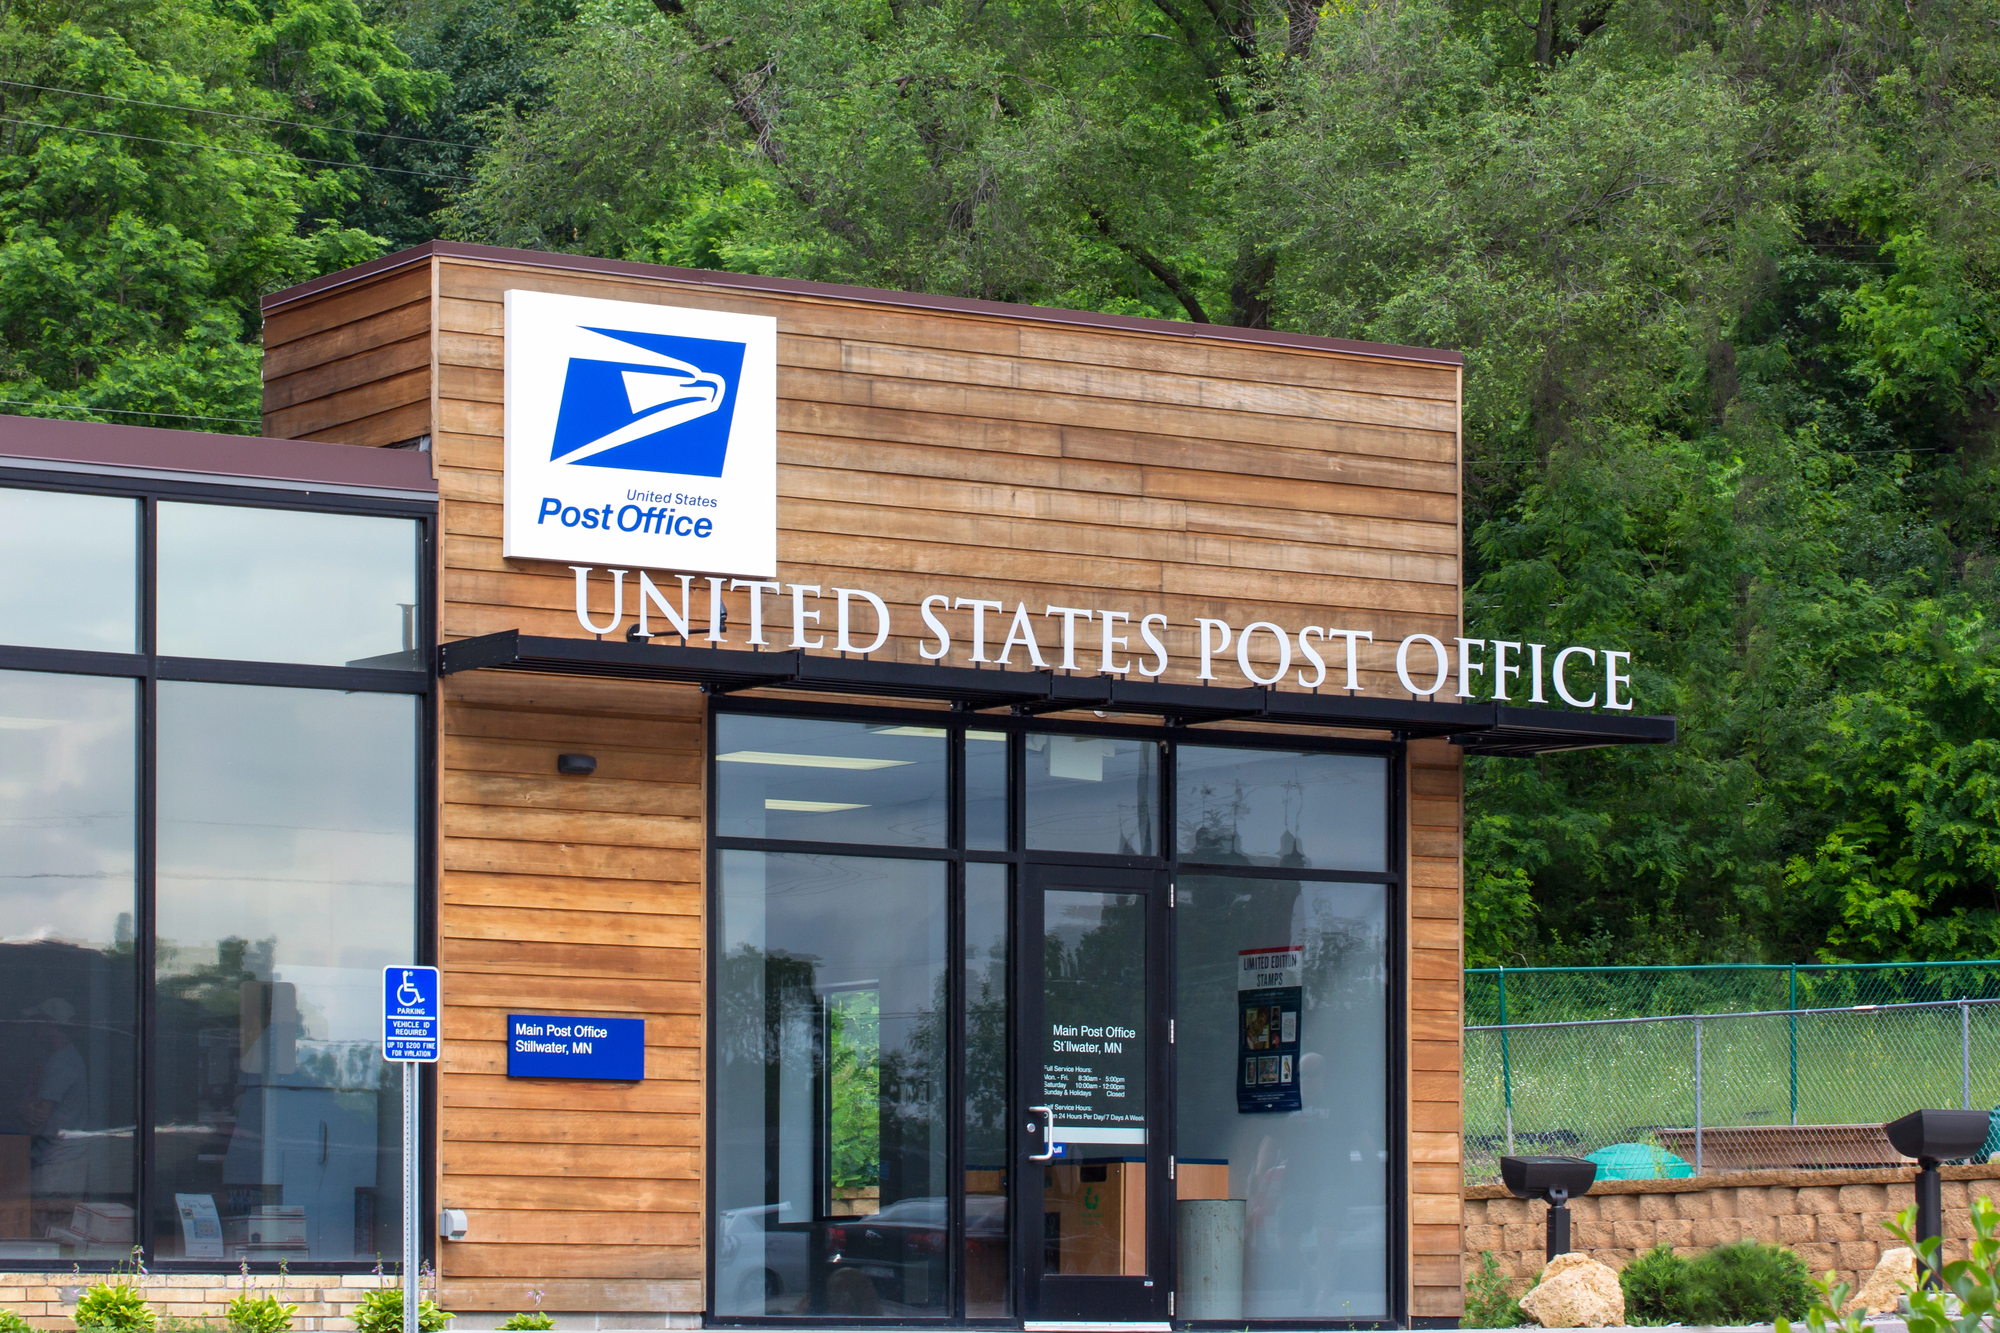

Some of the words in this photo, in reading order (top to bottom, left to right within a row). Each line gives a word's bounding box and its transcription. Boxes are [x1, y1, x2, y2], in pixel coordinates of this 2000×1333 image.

[627, 489, 672, 504] United
[675, 493, 718, 508] States
[537, 497, 613, 530] Post
[617, 503, 713, 538] Office
[568, 566, 890, 654] UNITED
[919, 594, 1168, 677] STATES
[1194, 617, 1373, 691] POST
[1396, 633, 1633, 711] OFFICE
[1244, 956, 1269, 970] LIMITED
[1257, 972, 1283, 987] STAMPS
[515, 1023, 543, 1037] Main
[546, 1025, 571, 1037] Post
[574, 1026, 608, 1038] Office
[1053, 1024, 1077, 1036] Main
[1081, 1025, 1103, 1037] Post
[1106, 1026, 1136, 1038] Office
[515, 1040, 569, 1055] Stillwater,
[573, 1042, 592, 1054] MN
[1104, 1042, 1122, 1053] MN
[1044, 1081, 1066, 1089] Saturday
[1103, 1083, 1125, 1091] 12:00pm
[1111, 1114, 1124, 1122] Days
